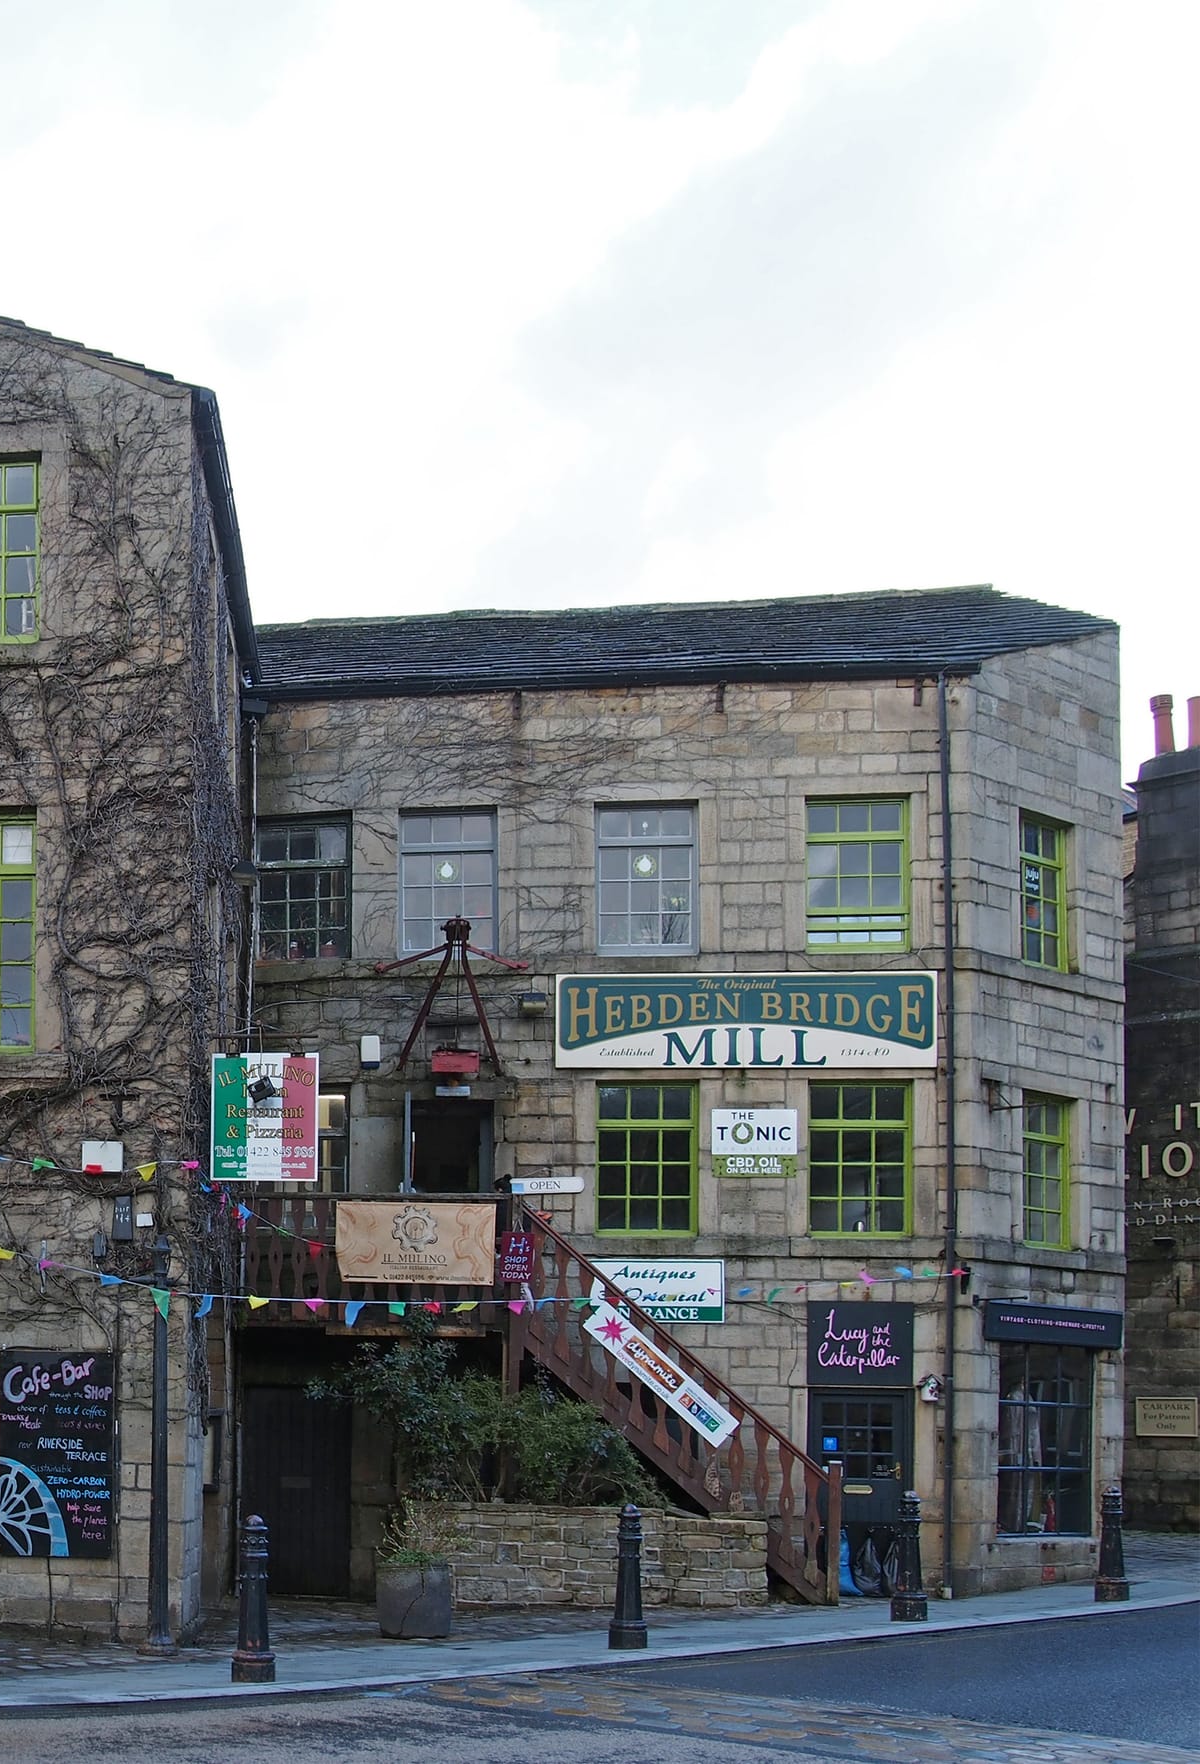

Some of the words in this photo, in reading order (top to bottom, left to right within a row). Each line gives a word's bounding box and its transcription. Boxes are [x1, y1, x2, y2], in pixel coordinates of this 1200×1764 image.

[697, 979, 720, 991] The
[724, 979, 776, 992] Original
[567, 987, 741, 1042] HEBDEN
[761, 985, 926, 1042] BRIDGE
[600, 1048, 655, 1057] Established
[662, 1027, 827, 1066] MILL
[218, 1071, 237, 1087] IL
[240, 1063, 315, 1087] MULINO
[226, 1104, 305, 1118] Restaurant
[731, 1112, 754, 1120] THE
[226, 1124, 239, 1139] &
[245, 1123, 304, 1139] Pizzeria
[716, 1122, 791, 1145] TONIC
[726, 1157, 754, 1167] CBD
[759, 1157, 782, 1167] OIL
[530, 1181, 561, 1191] OPEN
[383, 1253, 393, 1263] IL
[398, 1254, 446, 1264] MULINO
[504, 1256, 528, 1264] SHOP
[504, 1264, 528, 1272] OPEN
[610, 1265, 696, 1283] Antiques
[501, 1272, 531, 1280] TODAY
[825, 1309, 869, 1353] Lucy
[873, 1322, 890, 1335] and
[872, 1334, 891, 1347] the
[818, 1342, 900, 1374] Caterpillar
[627, 1341, 678, 1390] dynamite
[3, 1357, 95, 1404] Cafe-Bar
[84, 1384, 113, 1400] SHOP
[17, 1405, 37, 1413] choice
[39, 1404, 48, 1415] of
[55, 1404, 71, 1414] teas
[82, 1404, 107, 1420] coffees
[1164, 1403, 1191, 1411] PARK
[1143, 1412, 1157, 1420] For
[1158, 1412, 1190, 1420] Patrons
[1156, 1422, 1176, 1431] Only
[37, 1437, 84, 1450] RIVERSIDE
[65, 1451, 107, 1462] TERRACE
[47, 1476, 106, 1487] ZERO-CARBON
[56, 1489, 111, 1500] HYDRO-POWER
[67, 1502, 80, 1514] help
[71, 1514, 83, 1524] the
[84, 1515, 108, 1528] planet
